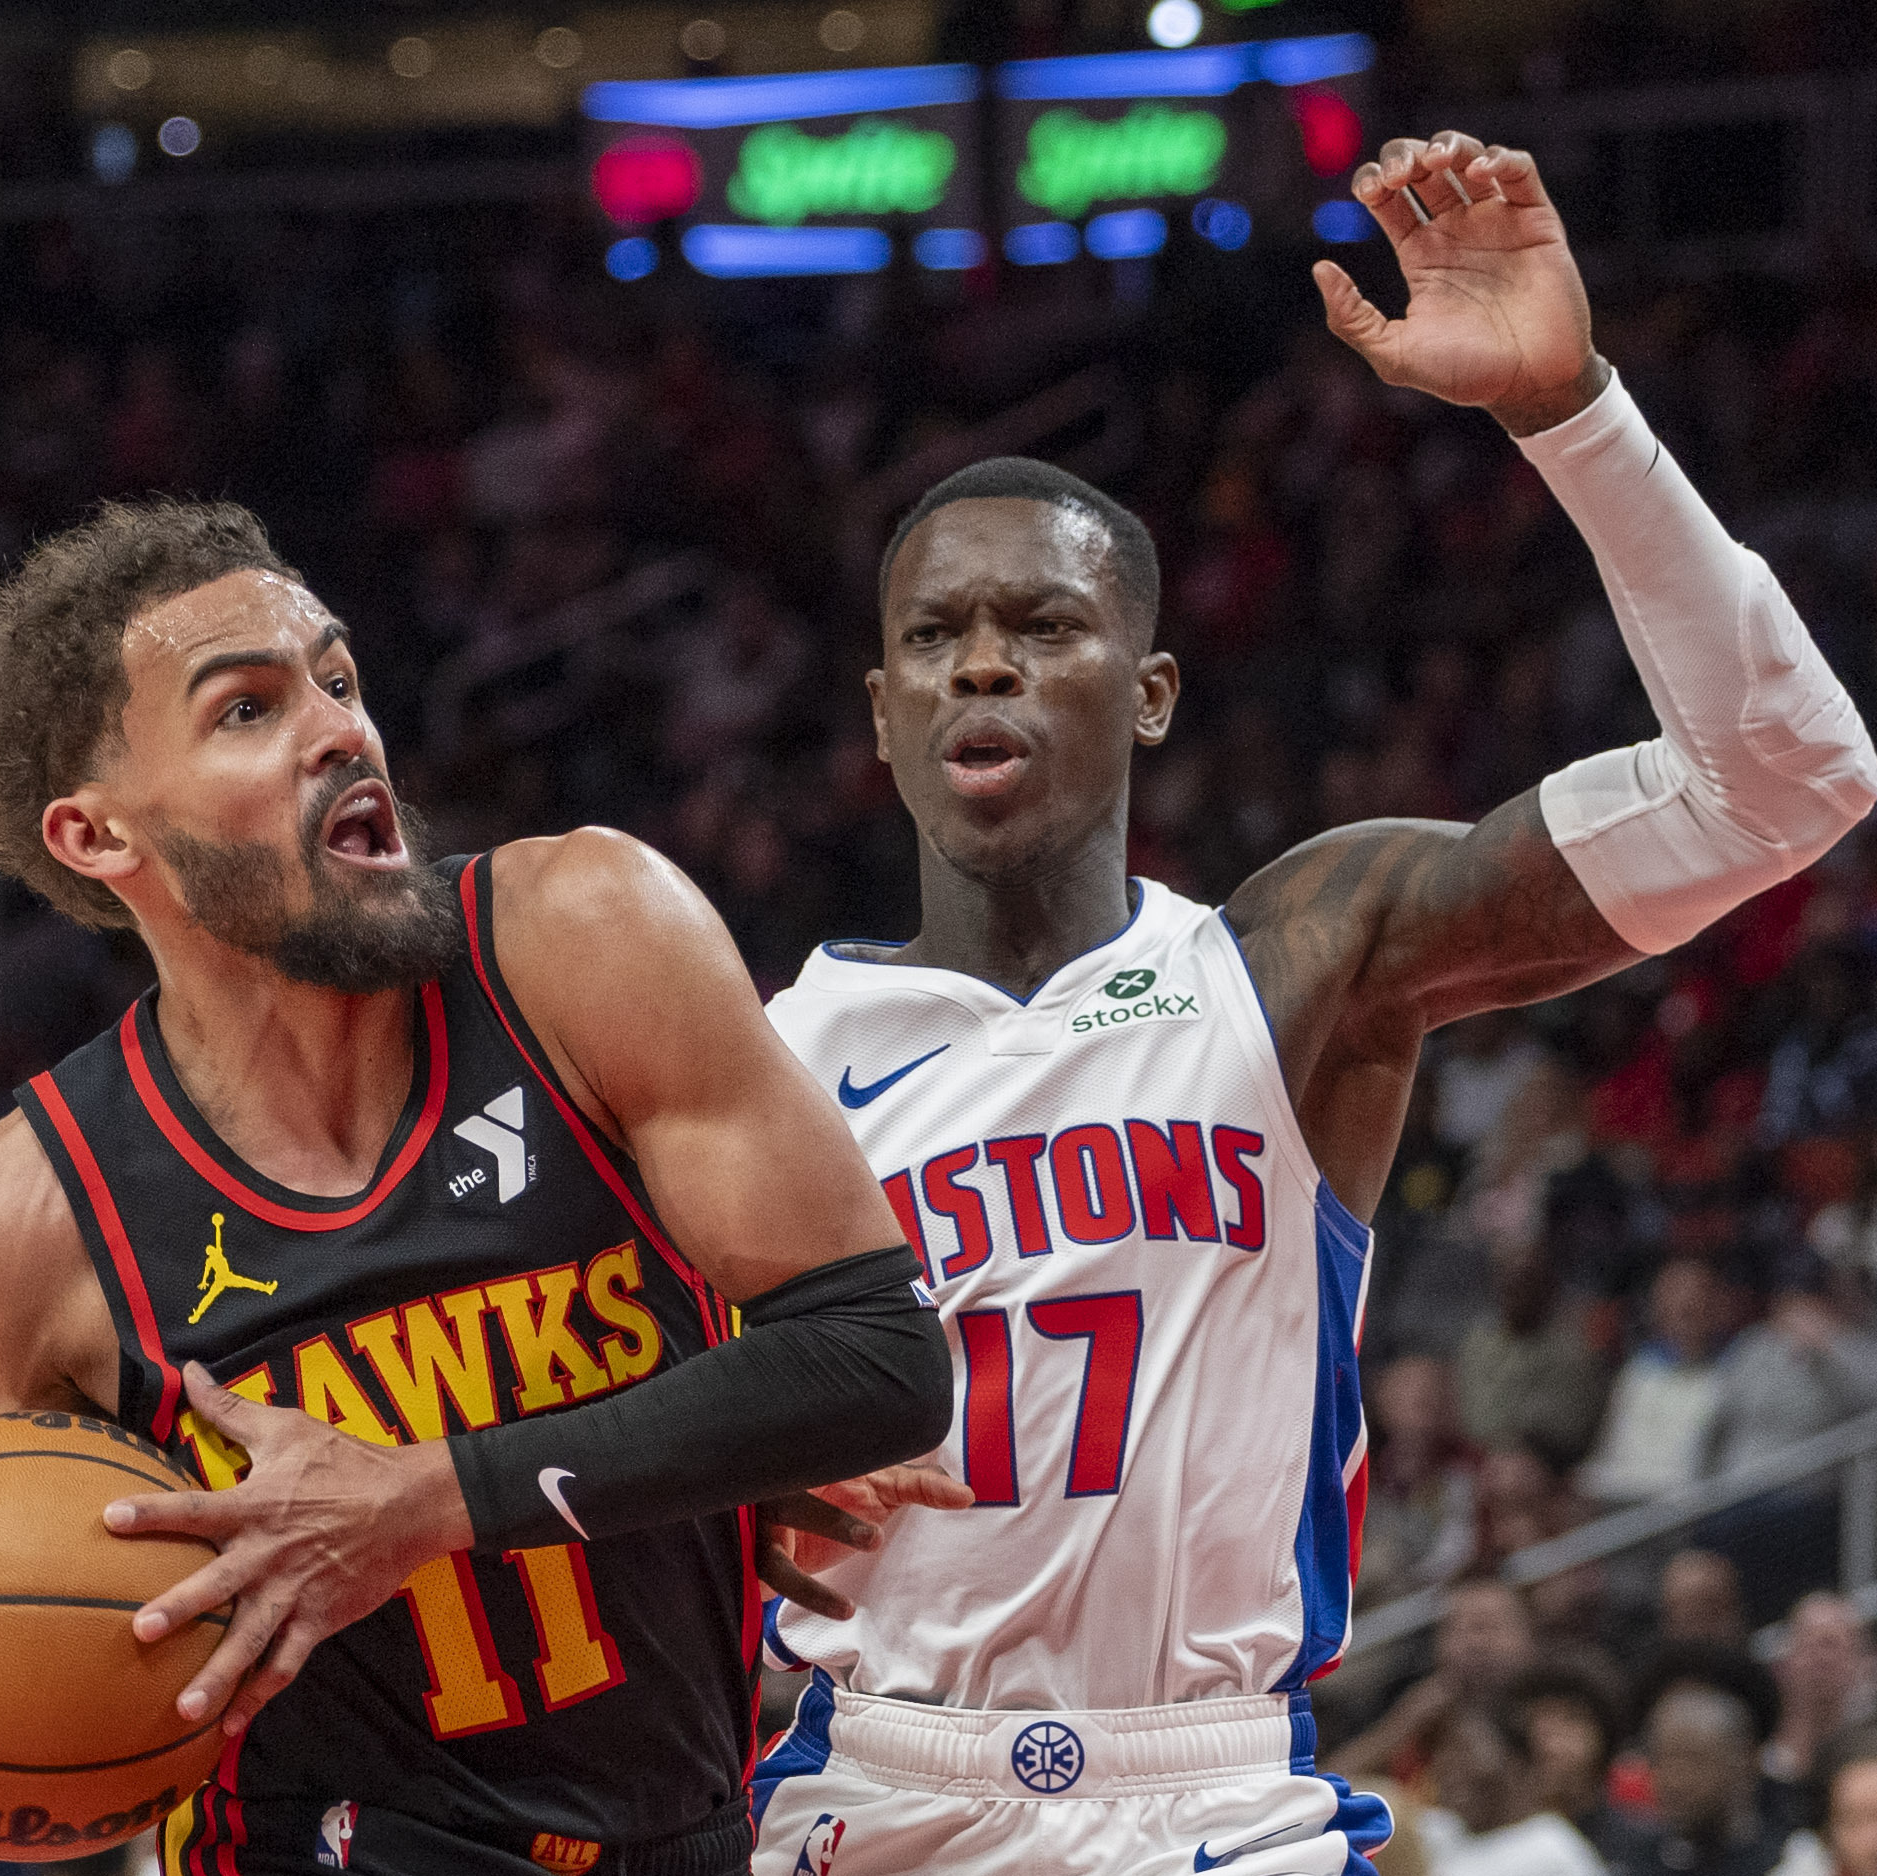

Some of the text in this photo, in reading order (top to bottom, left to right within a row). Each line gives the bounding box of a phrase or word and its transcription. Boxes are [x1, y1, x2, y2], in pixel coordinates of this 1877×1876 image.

[1072, 993, 1199, 1032] StockX
[449, 1168, 486, 1197] the
[527, 1154, 537, 1182] YMCA
[880, 1118, 1265, 1290] ISTONS
[957, 1290, 1143, 1507] 17
[391, 1541, 627, 1741] 11
[317, 1852, 335, 1867] NBA
[537, 1835, 588, 1865] ATL
